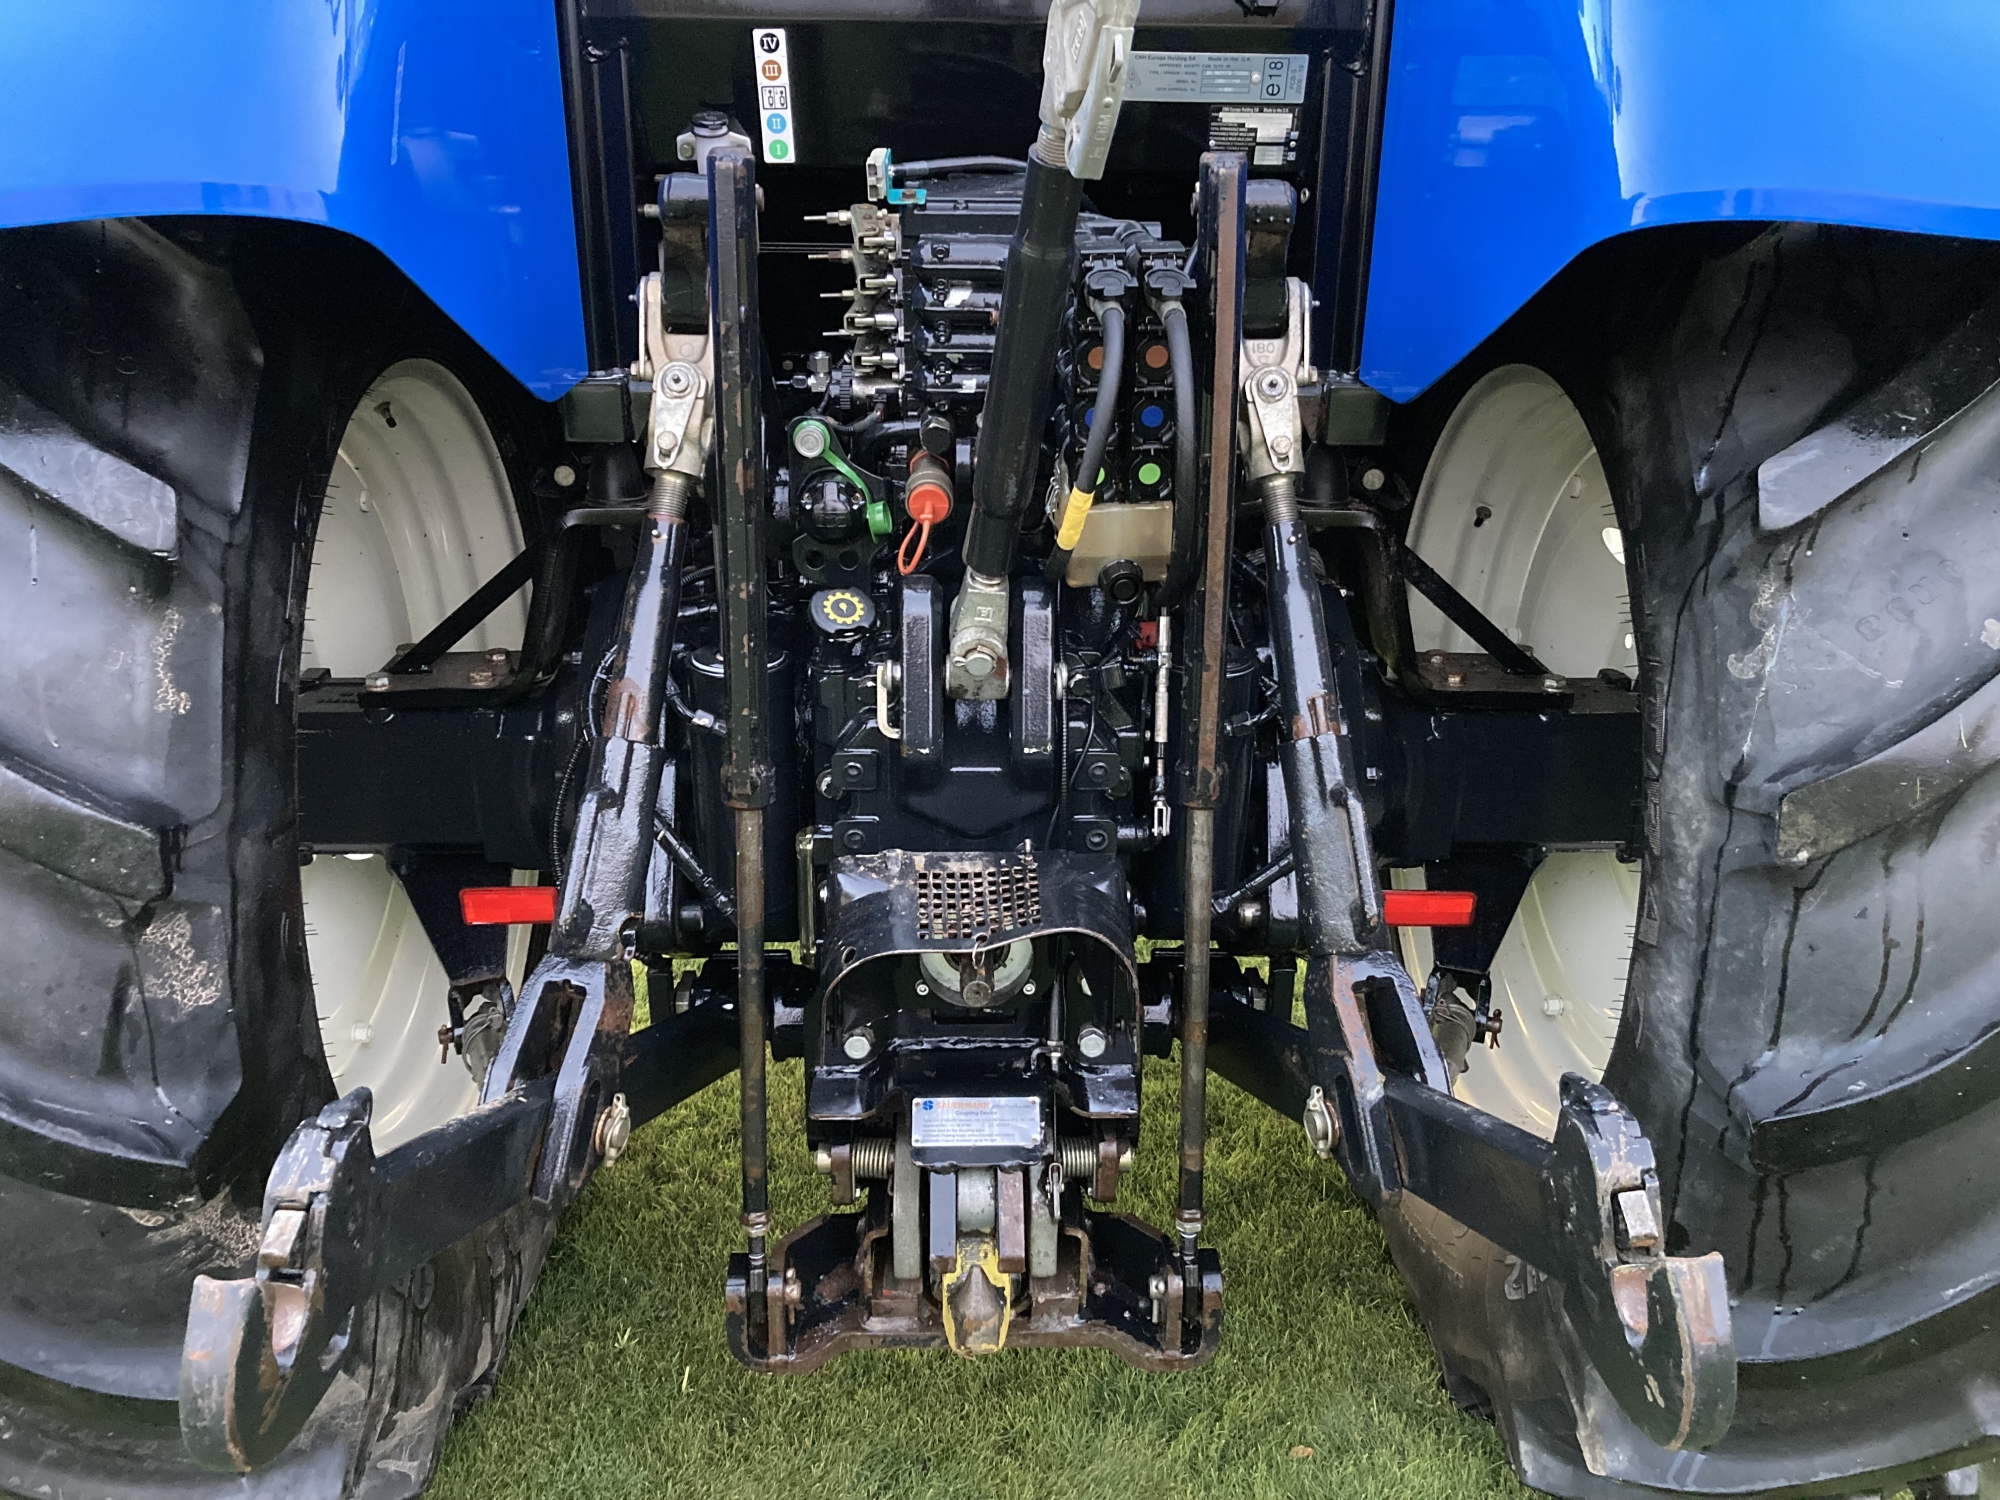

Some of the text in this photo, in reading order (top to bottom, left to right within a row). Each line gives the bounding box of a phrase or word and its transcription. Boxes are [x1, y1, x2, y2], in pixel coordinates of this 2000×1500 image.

[762, 37, 777, 49] IV
[764, 64, 778, 76] III
[1266, 61, 1284, 96] e18
[771, 118, 781, 129] II
[1095, 114, 1112, 141] CBM
[776, 144, 781, 155] I
[1252, 342, 1275, 354] 180
